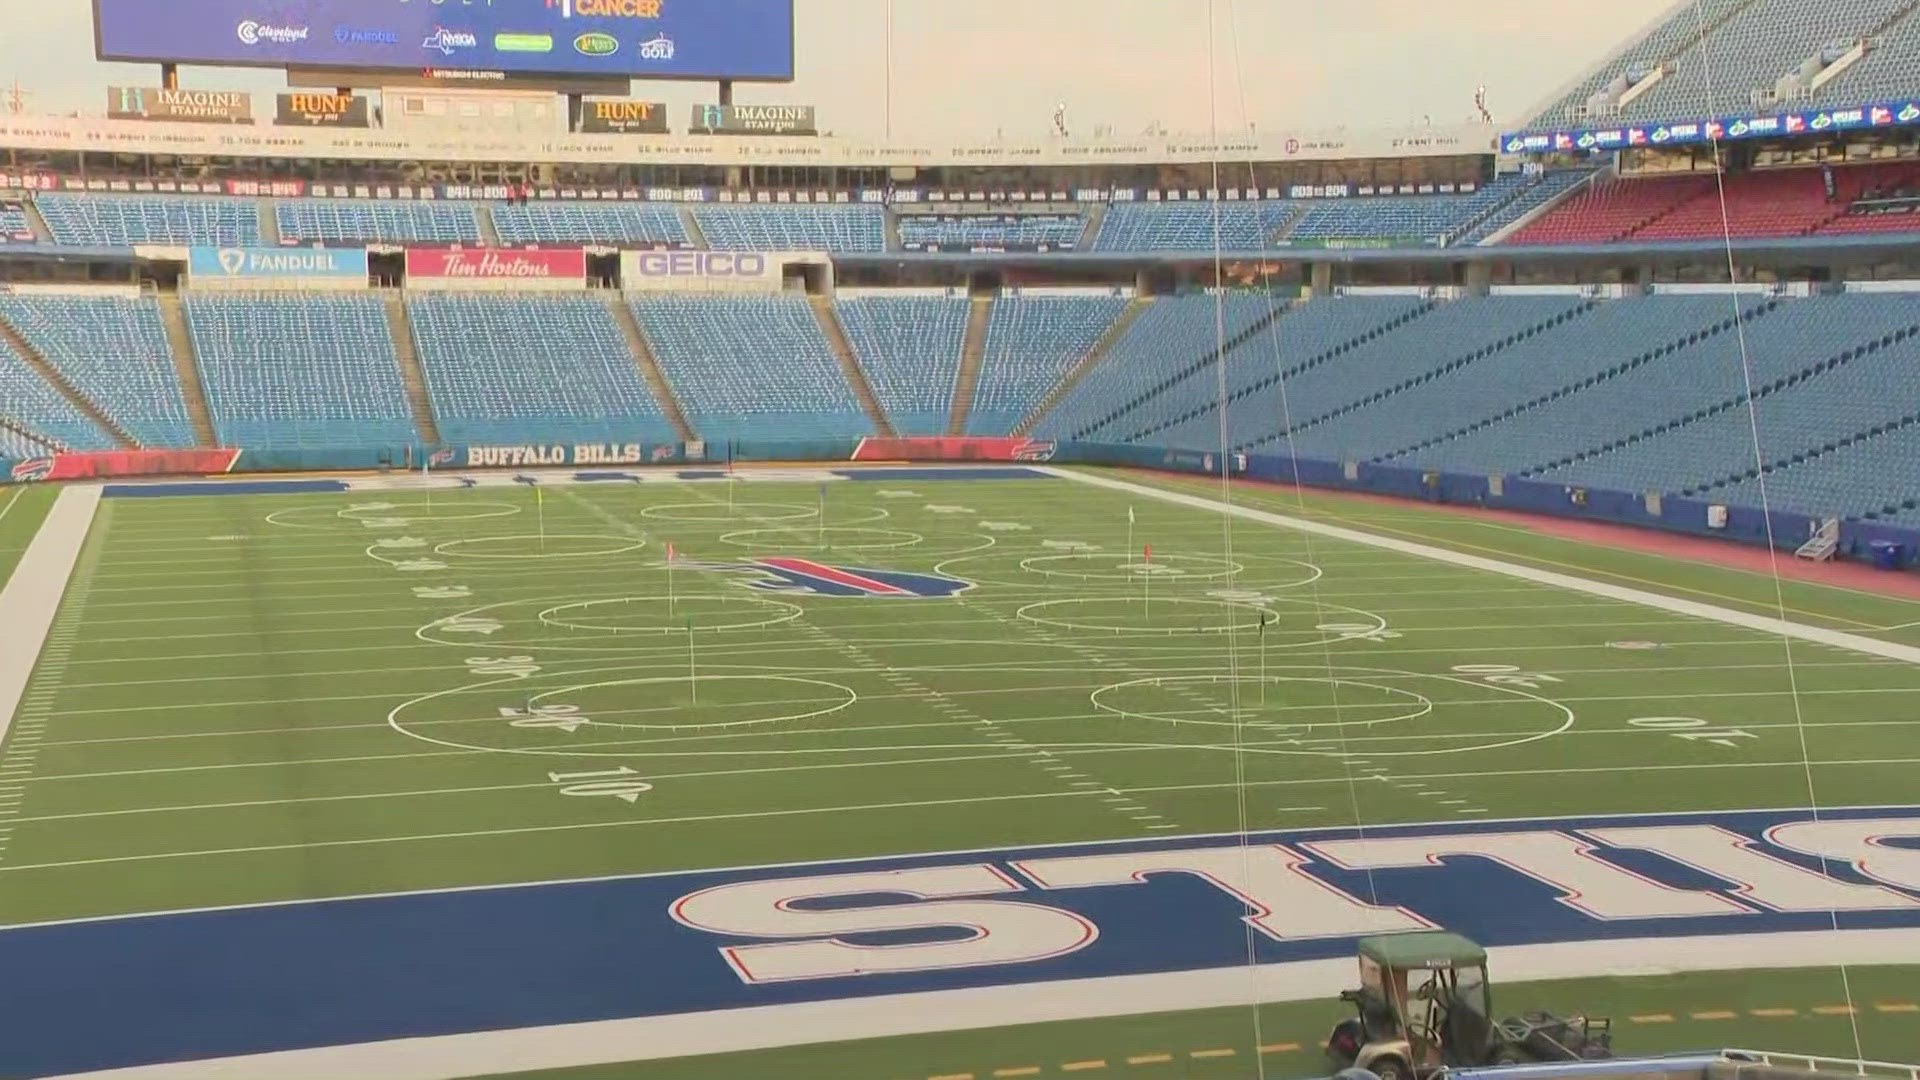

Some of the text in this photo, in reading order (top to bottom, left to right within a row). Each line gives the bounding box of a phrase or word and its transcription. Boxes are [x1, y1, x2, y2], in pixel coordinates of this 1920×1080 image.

[575, 0, 660, 17] CANCER
[157, 90, 241, 106] IMAGINE
[291, 94, 349, 113] HUNT
[170, 105, 228, 116] STAFFING
[596, 103, 649, 120] HUNT
[734, 107, 807, 121] IMAGINE
[744, 120, 795, 130] STAFFING
[251, 253, 339, 271] FANDUEL
[442, 253, 549, 277] Tim Hortons
[639, 252, 765, 276] GEICO
[467, 443, 641, 466] BUFFALO BILLS
